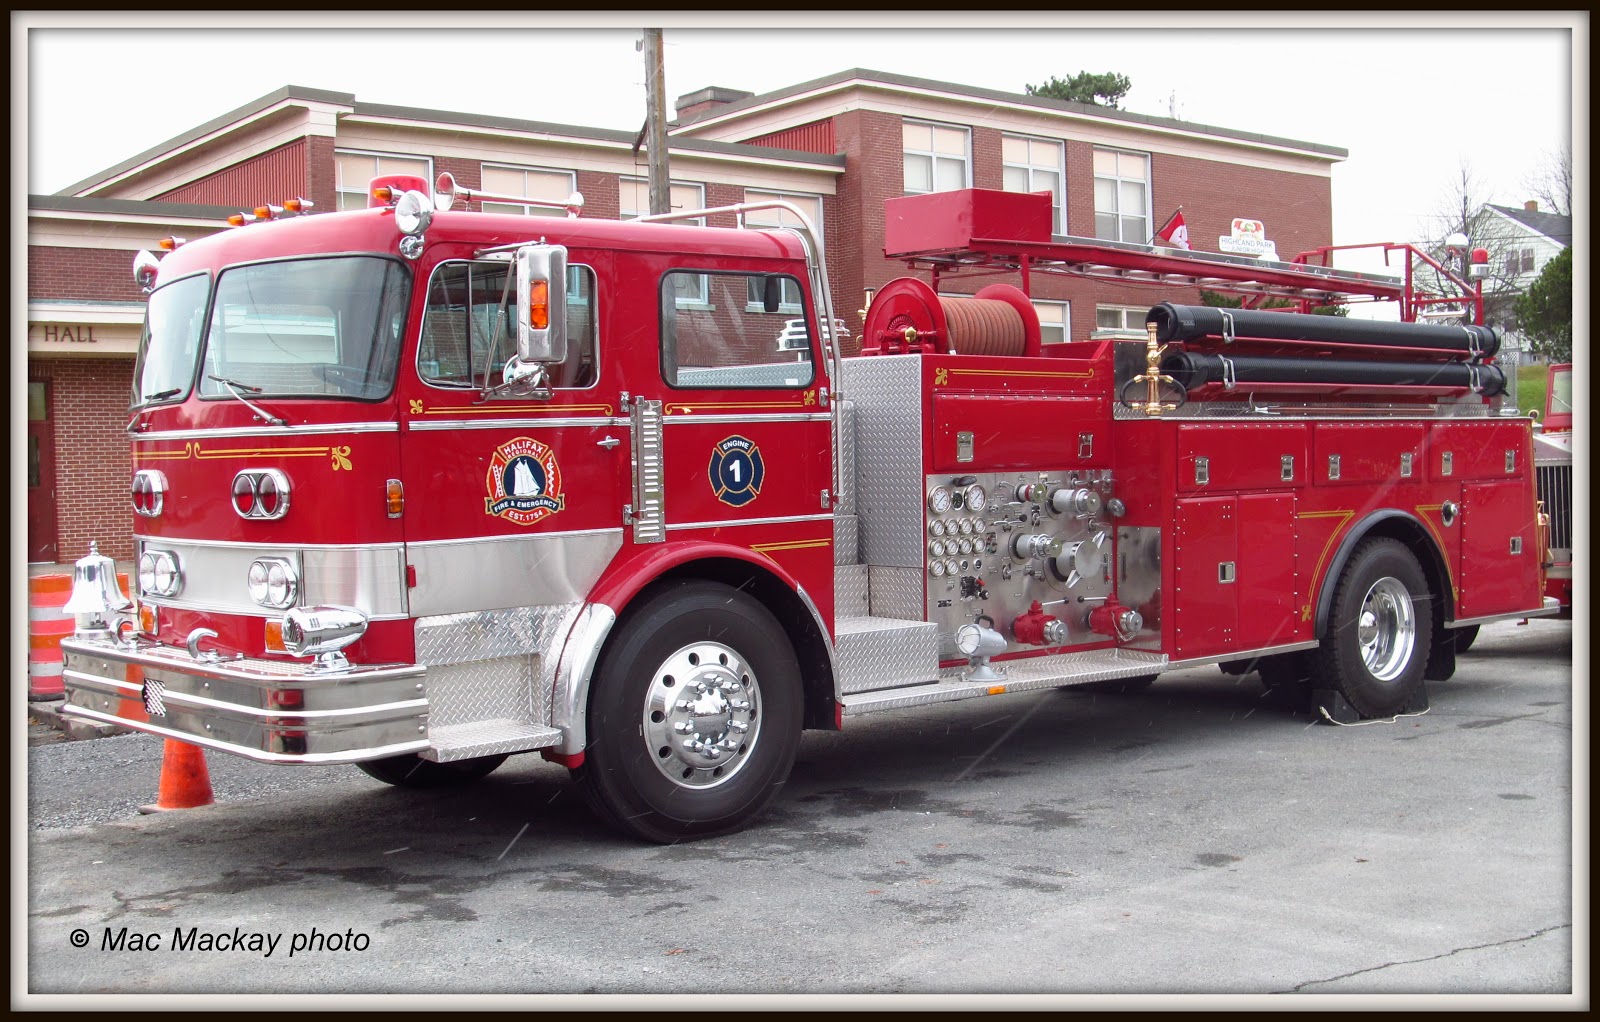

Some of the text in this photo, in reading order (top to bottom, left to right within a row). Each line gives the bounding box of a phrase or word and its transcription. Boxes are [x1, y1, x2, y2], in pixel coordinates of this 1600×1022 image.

[1221, 237, 1273, 249] HIGHLAND PARK
[1231, 245, 1250, 253] JUNIOR
[44, 325, 97, 343] HALL
[503, 440, 544, 455] HALIFAX
[722, 440, 750, 450] ENGINE
[507, 448, 539, 459] REGIONAL
[729, 459, 741, 482] 1
[493, 502, 509, 512] FIRE
[516, 499, 557, 509] EMERGENCY
